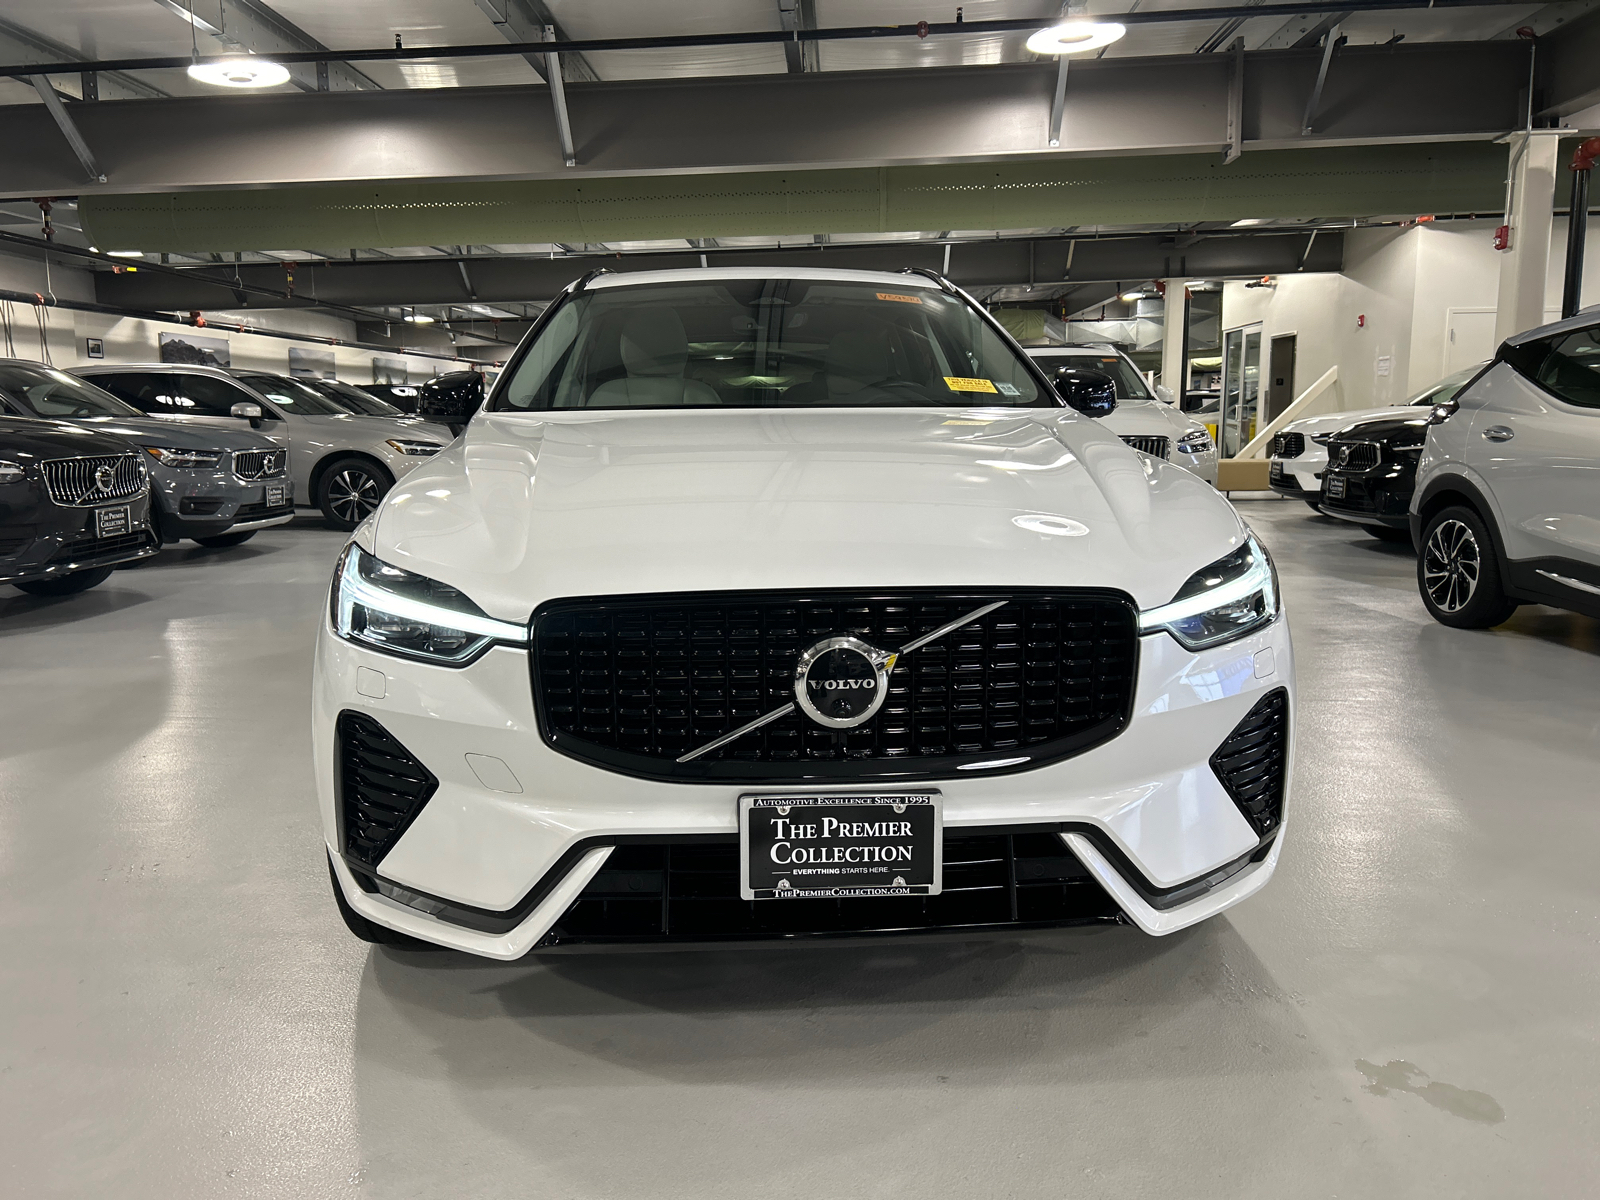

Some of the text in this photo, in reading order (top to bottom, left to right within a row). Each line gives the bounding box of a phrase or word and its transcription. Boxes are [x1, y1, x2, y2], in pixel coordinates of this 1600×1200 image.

[808, 679, 875, 690] VOLVO
[755, 796, 929, 807] AUTOMOTIVE EXCELLENCE SINCE 1995
[770, 817, 914, 840] THE PREMIER
[770, 841, 914, 864] COLLECTION
[792, 867, 840, 875] EVERYTHING
